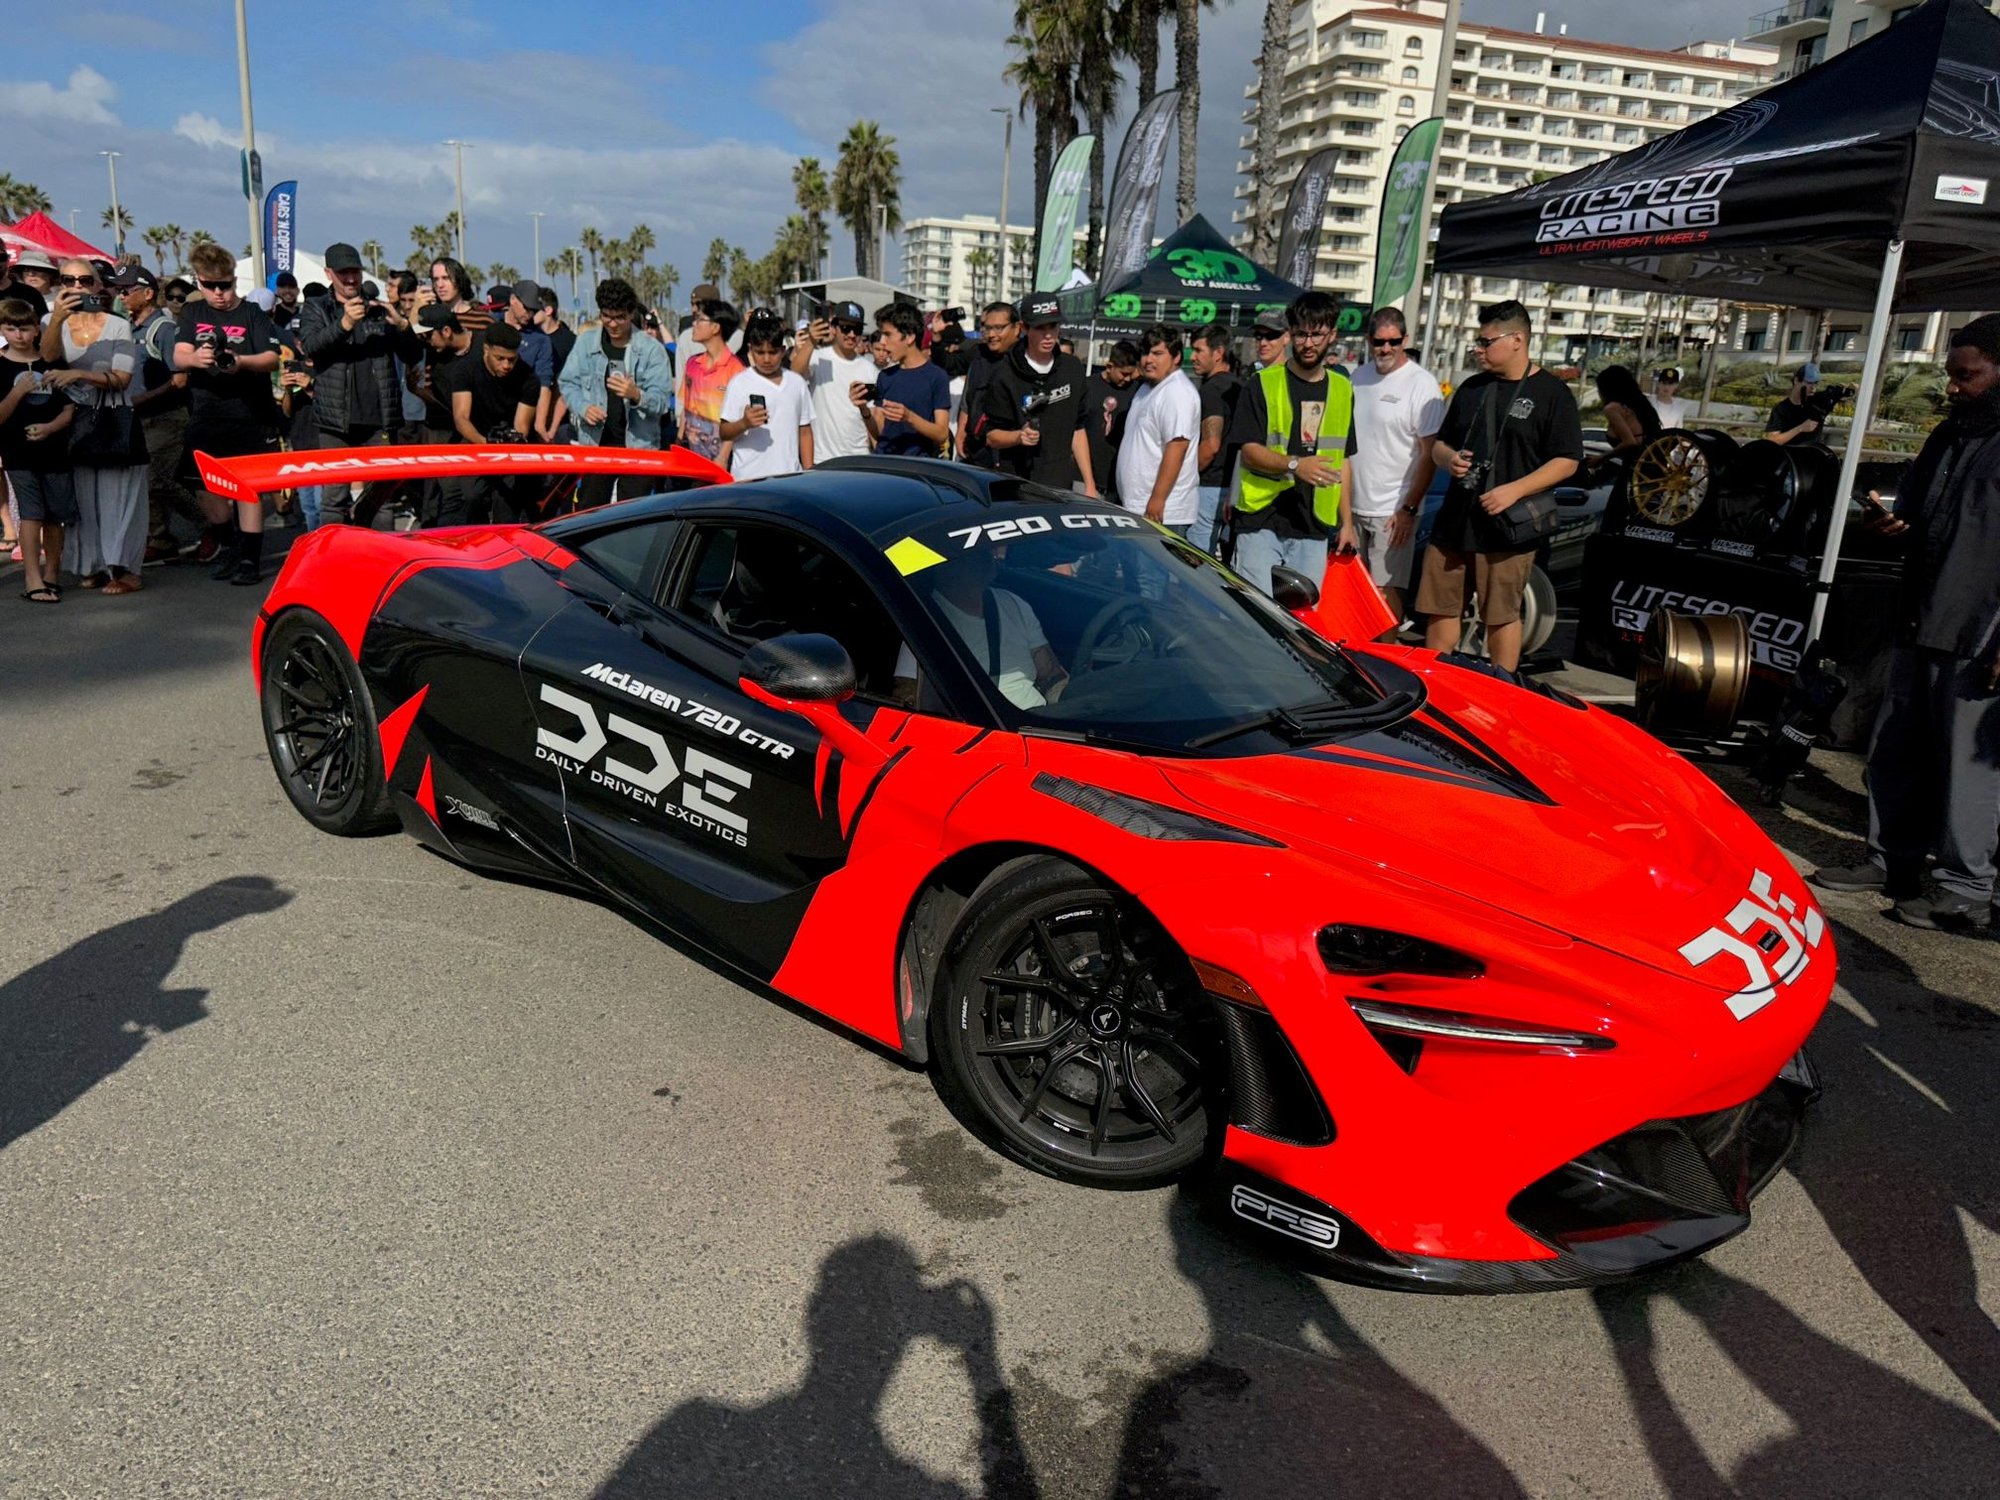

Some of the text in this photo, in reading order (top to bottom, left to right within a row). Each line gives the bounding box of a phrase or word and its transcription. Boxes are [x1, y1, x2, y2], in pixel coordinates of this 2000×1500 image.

[277, 193, 291, 219] CARS
[1539, 167, 1734, 220] LITESPEED
[1538, 203, 1717, 241] RACING
[1654, 230, 1710, 245] WHEELS
[277, 229, 291, 271] COPTERS
[1166, 248, 1258, 283] 3D
[1180, 278, 1262, 291] LOS ANGELES
[1103, 293, 1141, 319] 3D
[1179, 298, 1217, 324] 3D
[277, 454, 477, 476] McLaren
[477, 452, 575, 463] 720
[947, 514, 1141, 549] 720 GTR
[580, 662, 796, 760] McLaren 720 GTR
[537, 682, 753, 834] DDE
[535, 746, 749, 848] DAILY DRIVEN EXOTICS
[1677, 867, 1825, 1022] DDE
